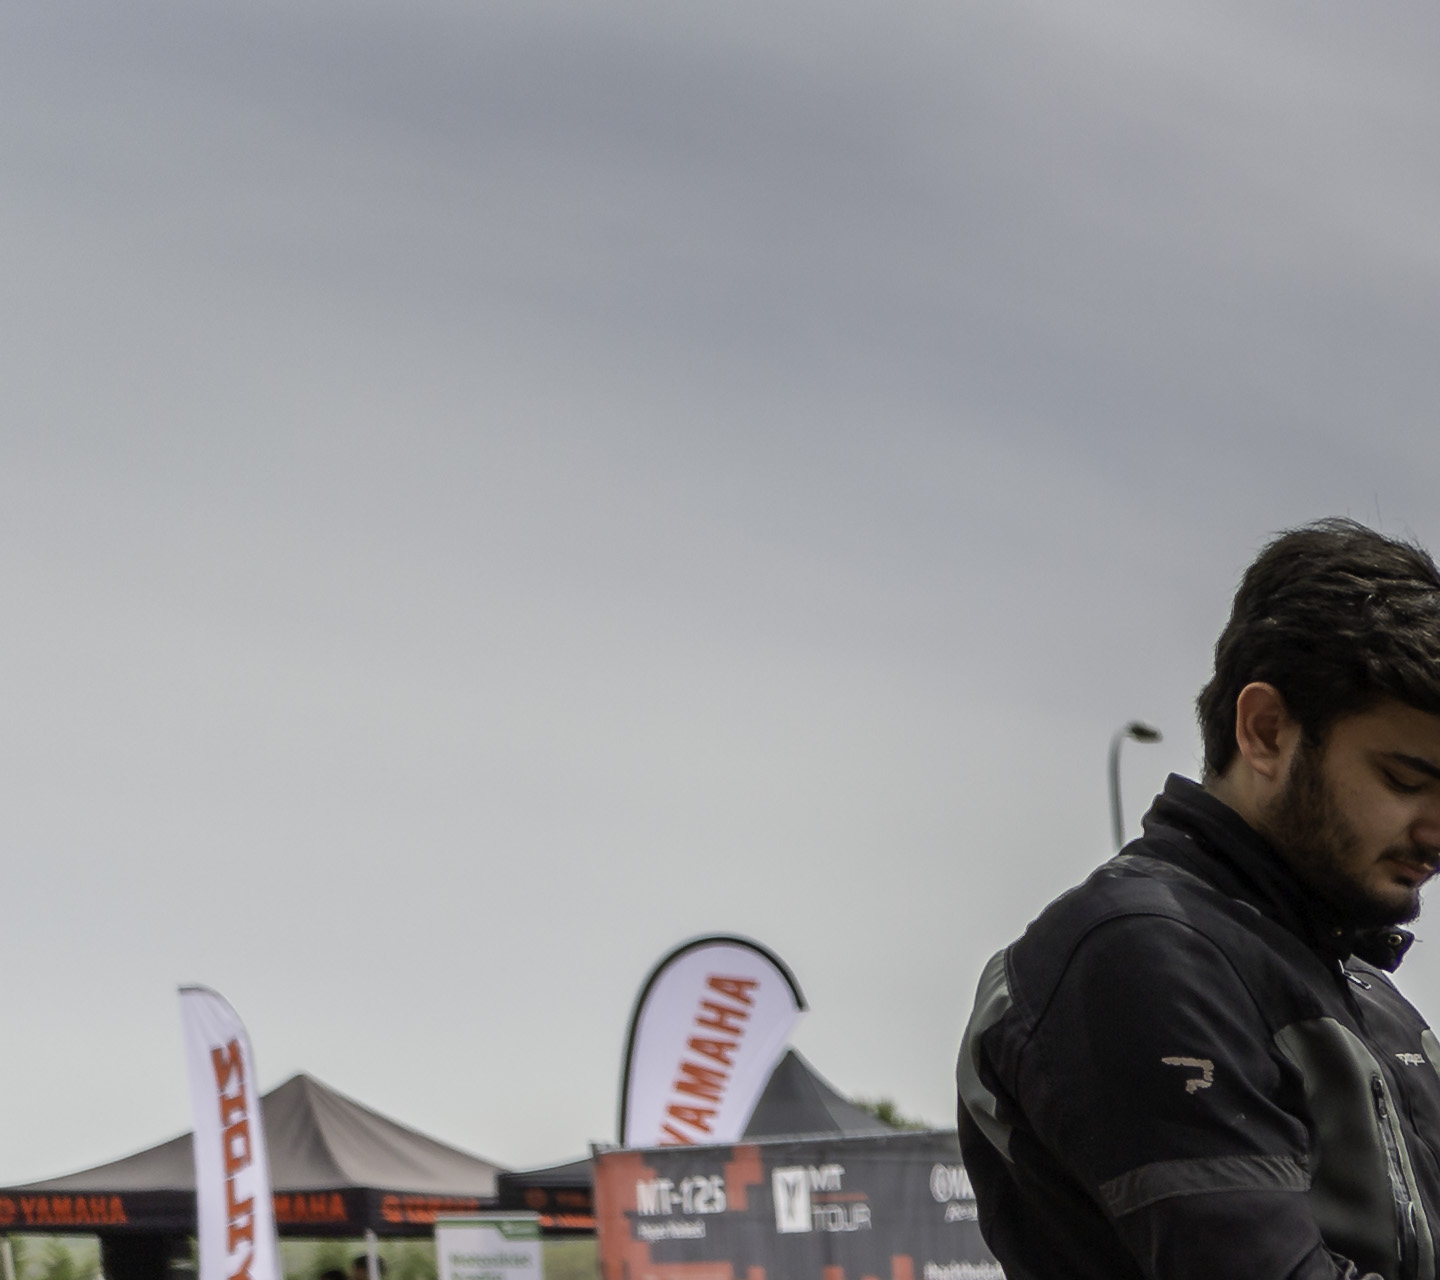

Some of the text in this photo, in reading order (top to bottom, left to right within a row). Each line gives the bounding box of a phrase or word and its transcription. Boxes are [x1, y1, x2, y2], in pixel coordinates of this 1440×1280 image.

[808, 1163, 846, 1191] MT
[274, 1194, 349, 1222] MAHA
[636, 1175, 728, 1216] MT-125
[23, 1196, 128, 1225] YAMAHA
[812, 1203, 873, 1231] TOUR
